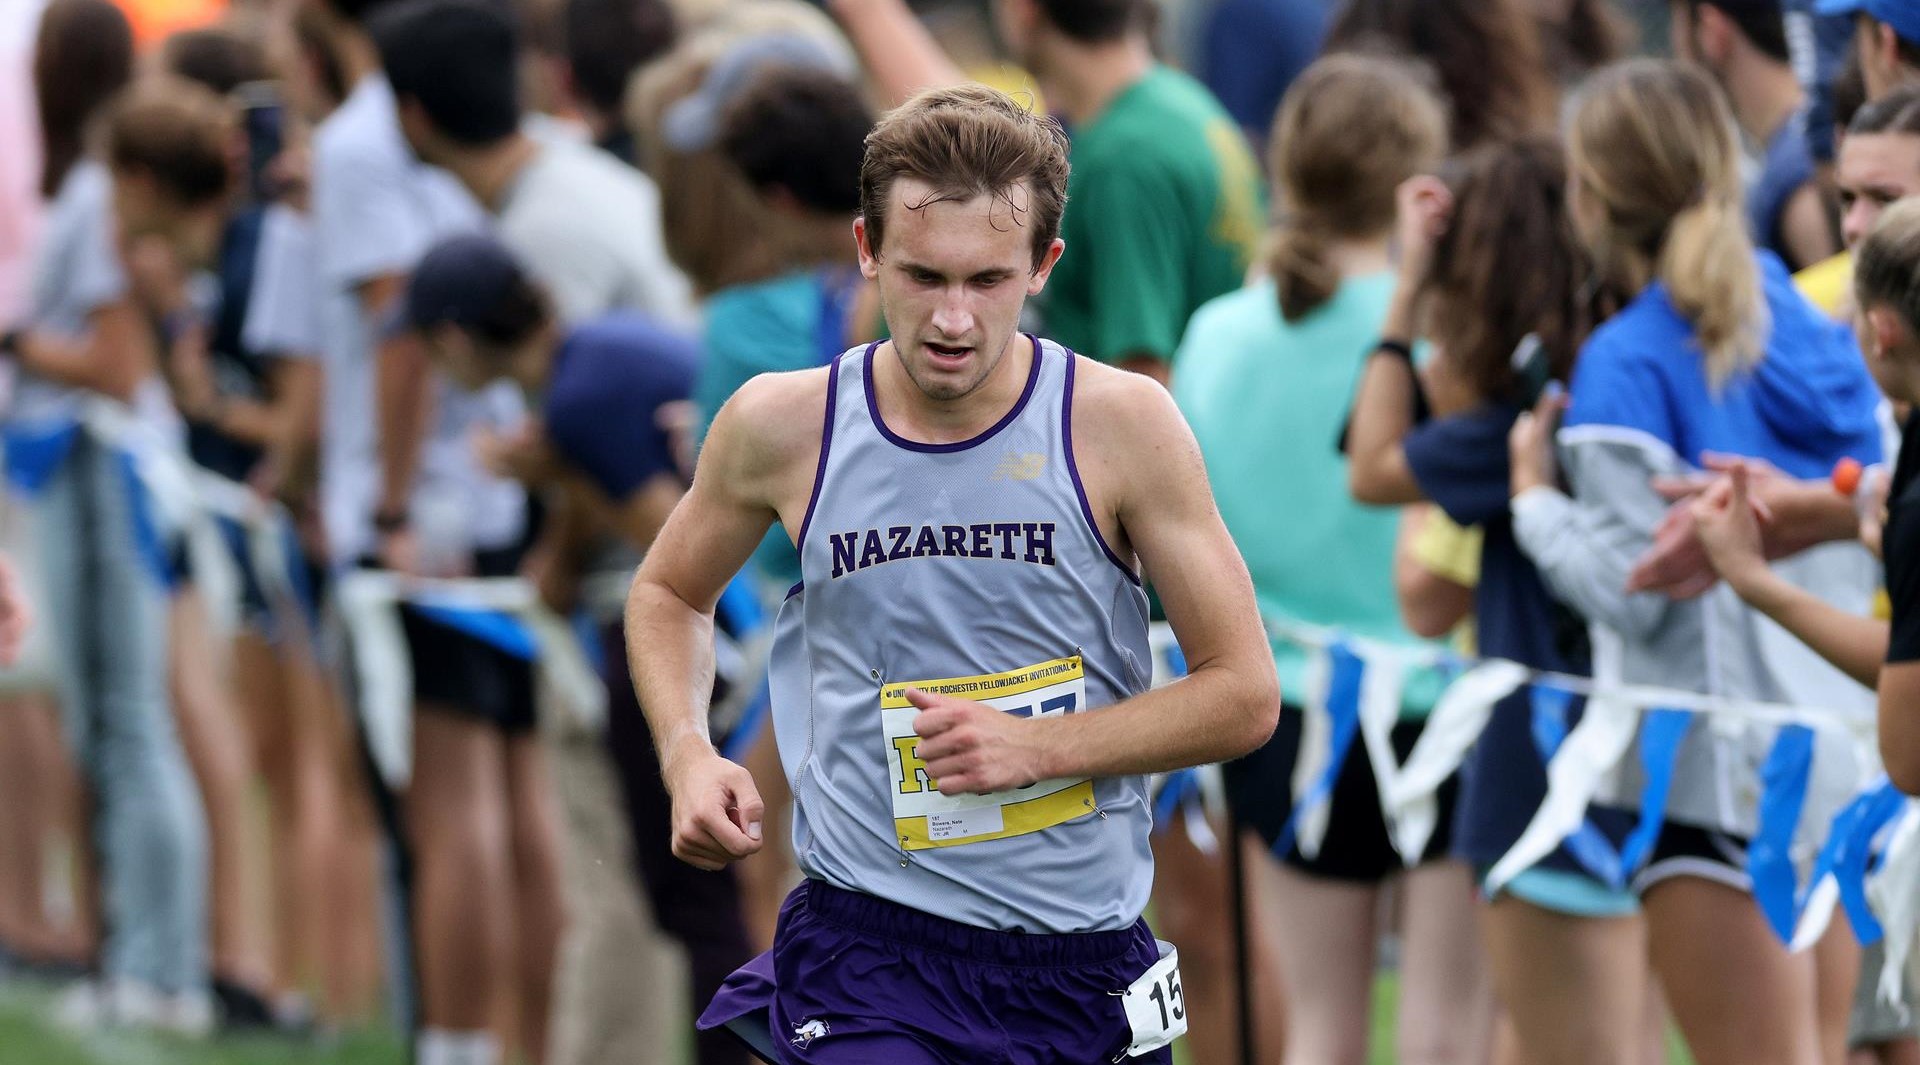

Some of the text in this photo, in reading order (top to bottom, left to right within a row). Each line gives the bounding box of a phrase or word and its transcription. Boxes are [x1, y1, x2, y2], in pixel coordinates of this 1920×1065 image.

[829, 522, 1056, 580] NAZARETH
[940, 682, 980, 694] ROCHESTER
[979, 673, 1028, 690] YELLOWJACKET
[1029, 662, 1071, 680] INVITATIONAL
[1149, 969, 1184, 1031] 15
